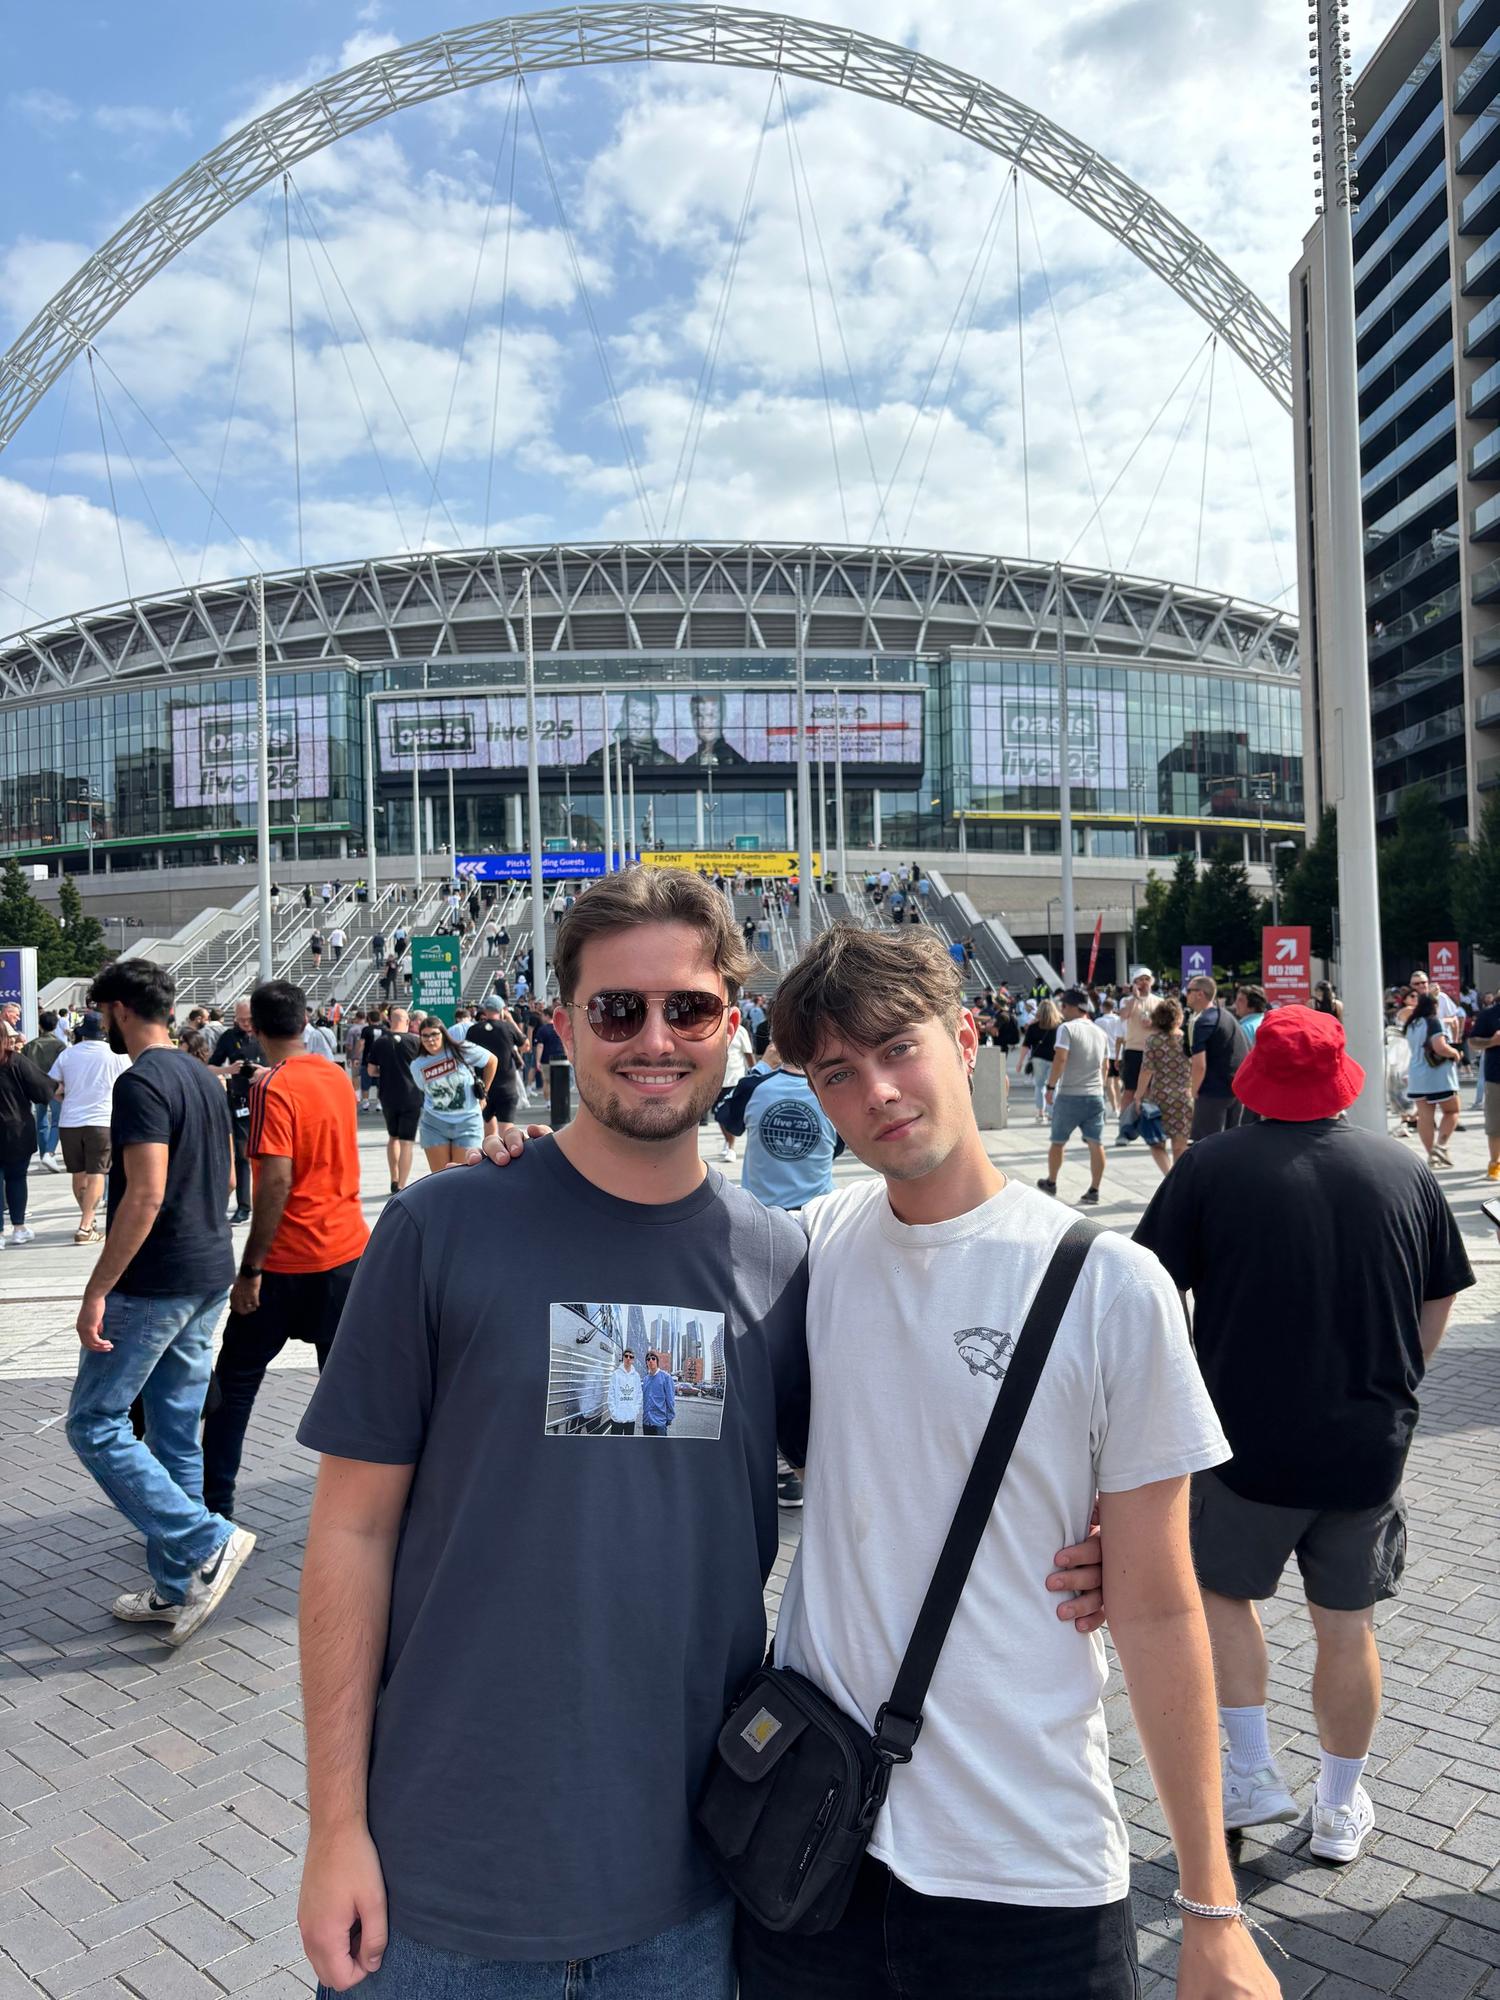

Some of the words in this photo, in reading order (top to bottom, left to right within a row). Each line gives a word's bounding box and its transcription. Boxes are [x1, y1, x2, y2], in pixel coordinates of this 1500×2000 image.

[486, 721, 529, 742] live
[536, 719, 574, 741] '25
[1011, 712, 1091, 737] oasis
[208, 723, 289, 753] oasis
[399, 722, 466, 746] oasis
[1001, 751, 1051, 777] live
[1058, 752, 1099, 778] 25
[200, 769, 248, 795] live
[506, 859, 525, 868] Pitch
[526, 858, 559, 868] Sding
[559, 858, 585, 866] Guests
[654, 854, 682, 862] FRONT
[419, 971, 436, 980] HAVE
[436, 970, 454, 979] YOUR
[1268, 964, 1284, 976] RED
[1284, 964, 1304, 976] ZONE
[424, 979, 450, 988] TICKETS
[420, 988, 441, 996] READY
[441, 987, 454, 996] FOR
[419, 996, 456, 1005] INSPECTION
[773, 1117, 793, 1128] live
[793, 1119, 809, 1130] '25
